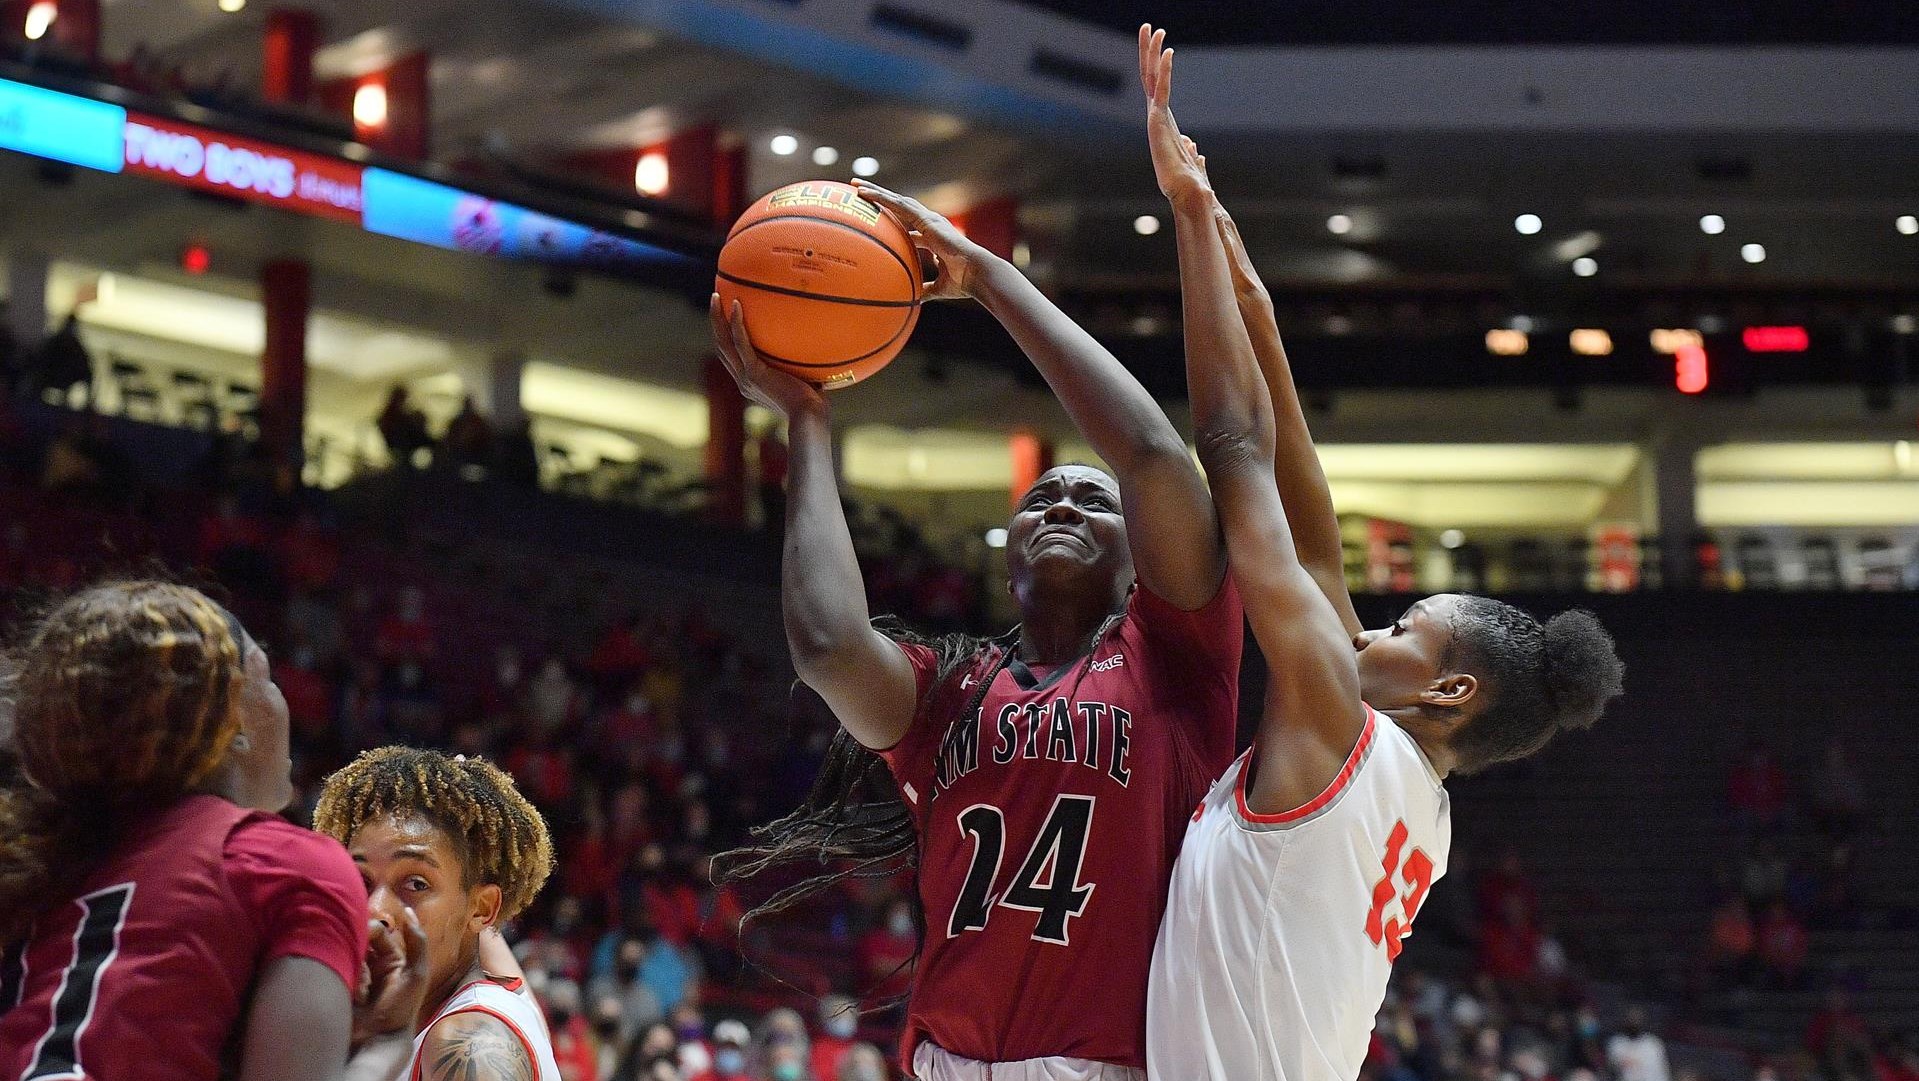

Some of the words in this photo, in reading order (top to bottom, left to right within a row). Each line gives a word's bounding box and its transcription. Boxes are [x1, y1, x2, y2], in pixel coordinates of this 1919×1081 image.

[125, 121, 205, 177] TWO
[204, 141, 296, 198] BOYS
[992, 697, 1132, 788] STATE
[946, 793, 1097, 947] 24
